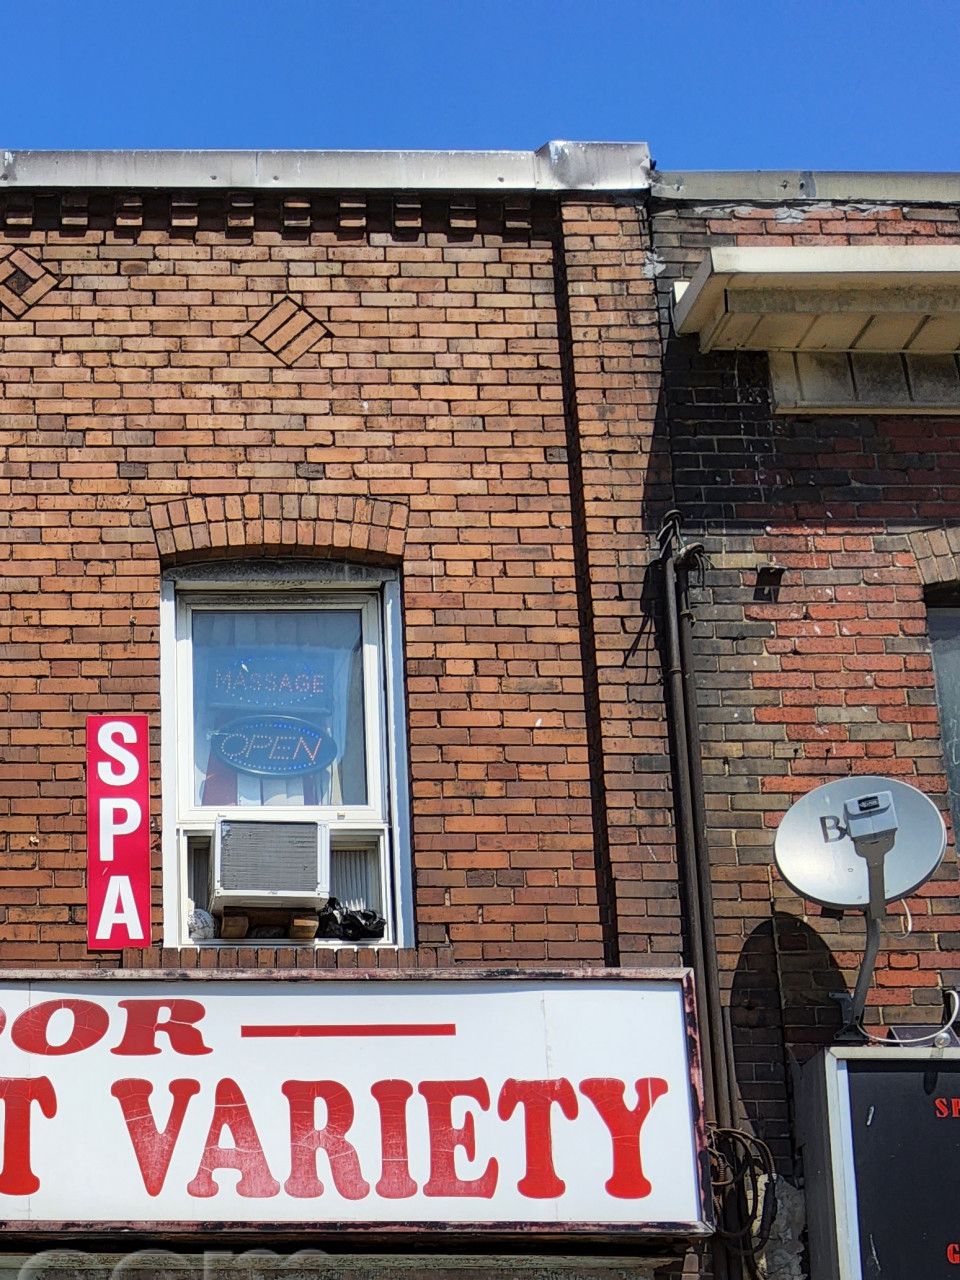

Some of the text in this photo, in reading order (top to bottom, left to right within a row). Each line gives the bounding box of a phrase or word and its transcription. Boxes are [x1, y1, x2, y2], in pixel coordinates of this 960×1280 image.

[220, 733, 322, 762] OPEN
[96, 721, 143, 942] SPA
[110, 1076, 669, 1200] VARIETY
